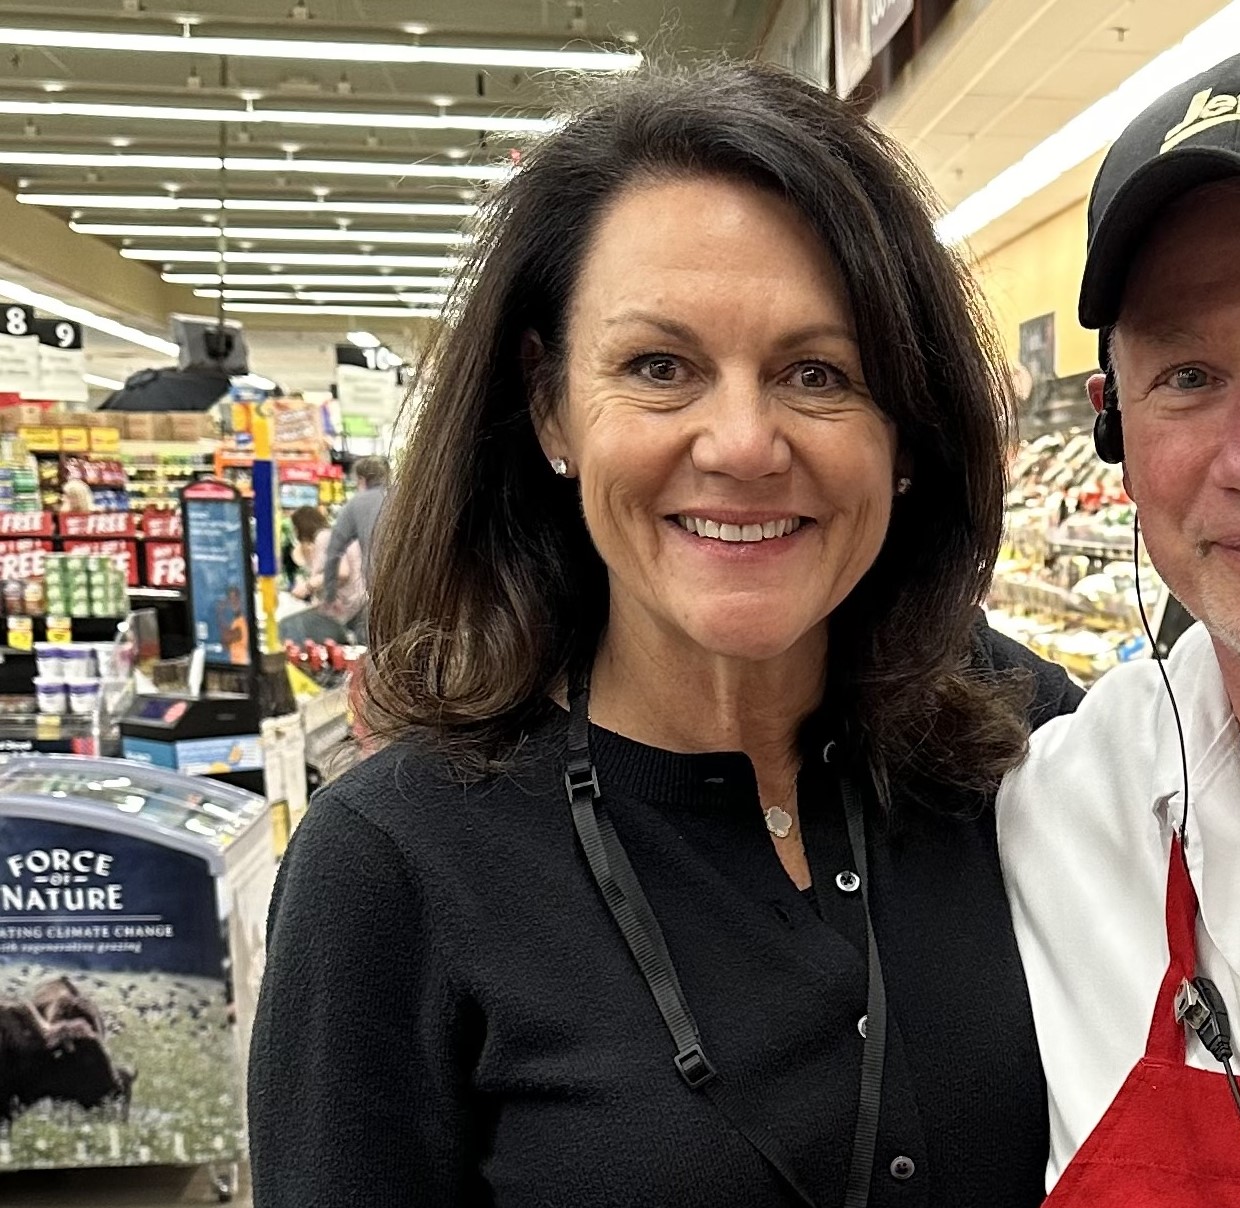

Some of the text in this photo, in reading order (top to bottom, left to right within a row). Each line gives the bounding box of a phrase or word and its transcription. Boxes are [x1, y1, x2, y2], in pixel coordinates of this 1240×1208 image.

[6, 306, 27, 335] 8
[55, 322, 75, 347] 9
[0, 549, 46, 580] REE
[153, 557, 186, 586] FR
[7, 848, 114, 877] FORCE
[50, 873, 70, 886] OF
[0, 884, 124, 911] NATURE
[47, 926, 109, 939] CLIMATE
[114, 925, 174, 938] CHANGE
